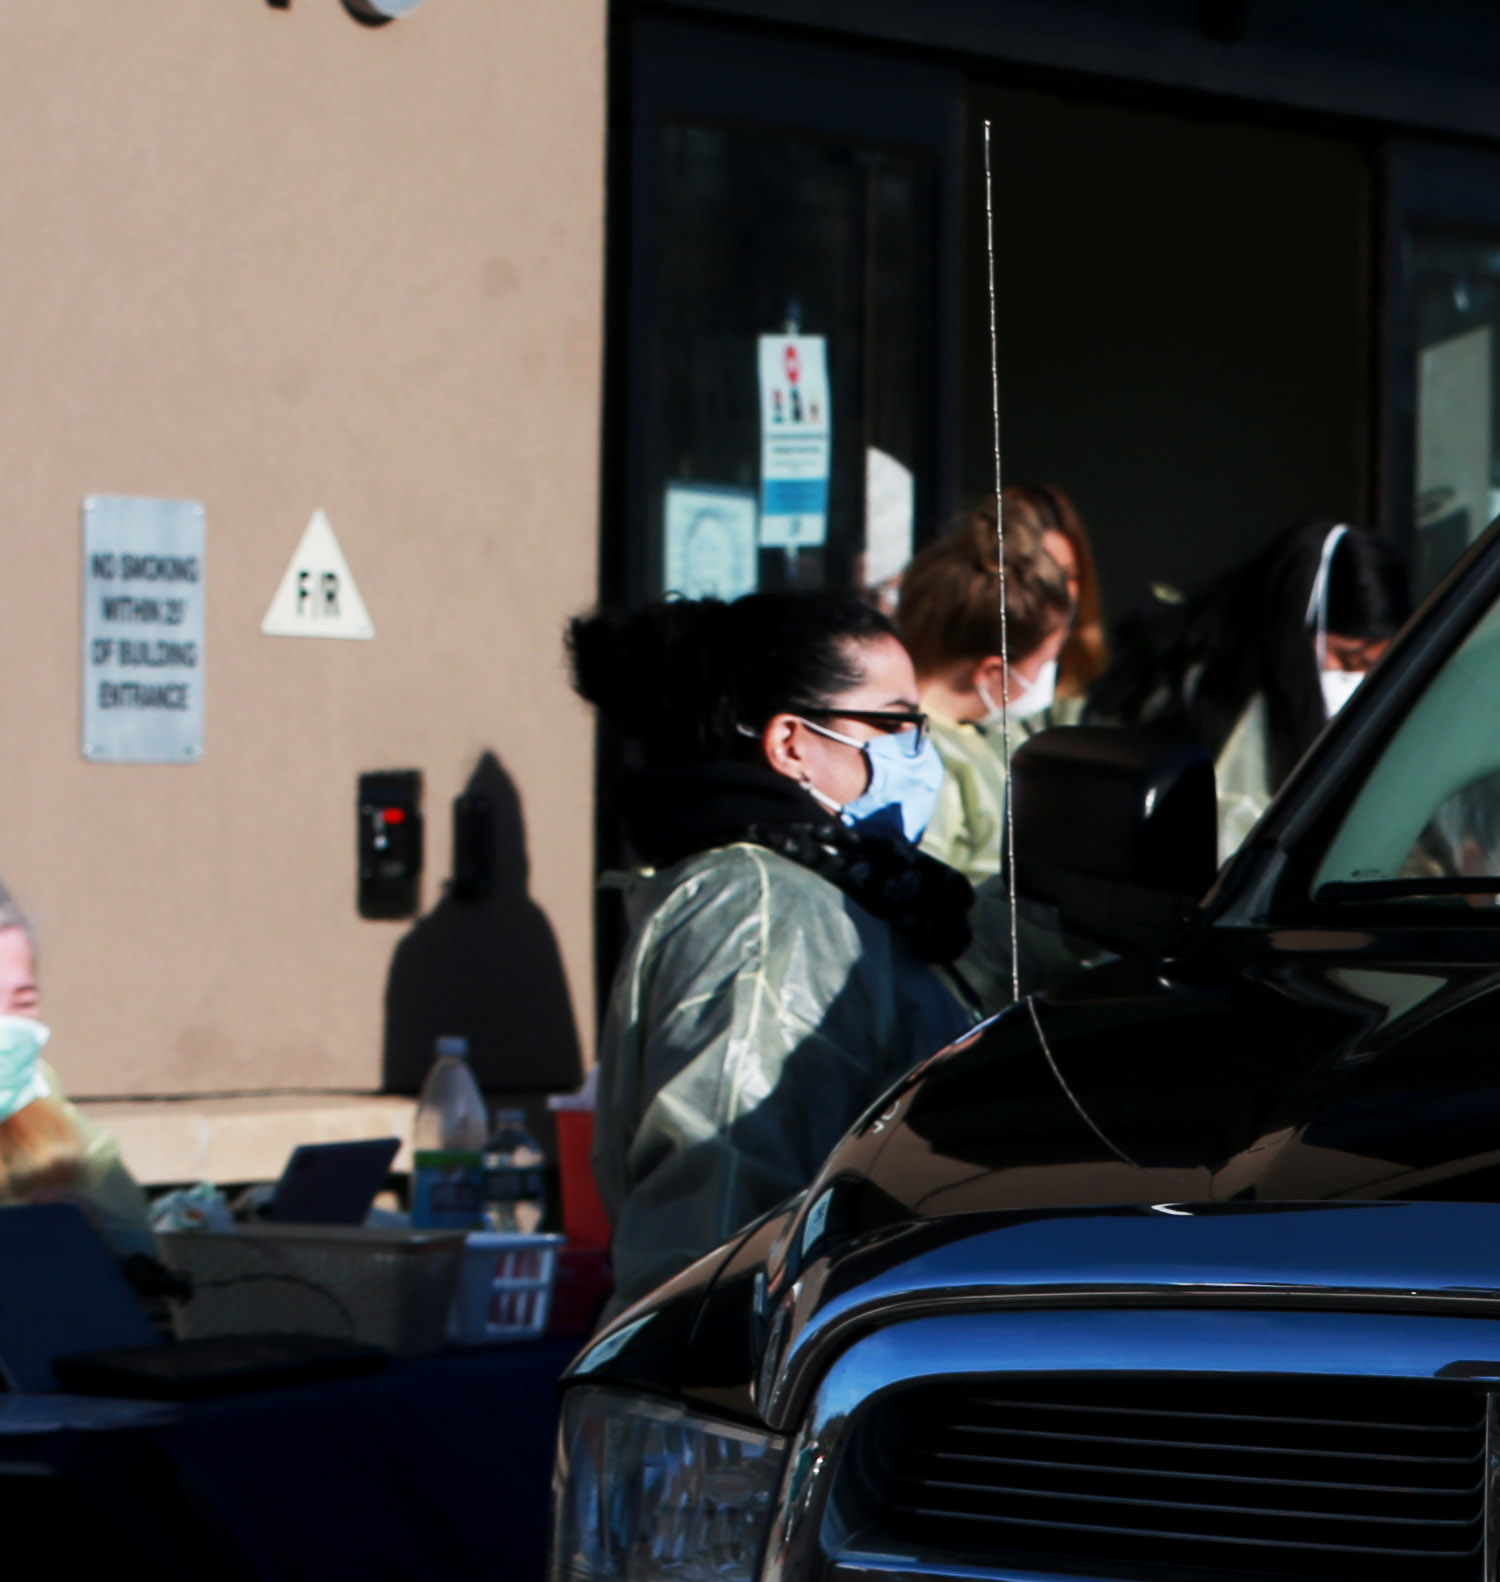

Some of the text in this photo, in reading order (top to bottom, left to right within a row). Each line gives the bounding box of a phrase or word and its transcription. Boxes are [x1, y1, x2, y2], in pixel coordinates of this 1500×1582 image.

[92, 554, 198, 583] NO SMOKING
[104, 598, 158, 622] WITHIN
[93, 640, 196, 667] OF BUILDING
[100, 683, 188, 710] ENTRANCE
